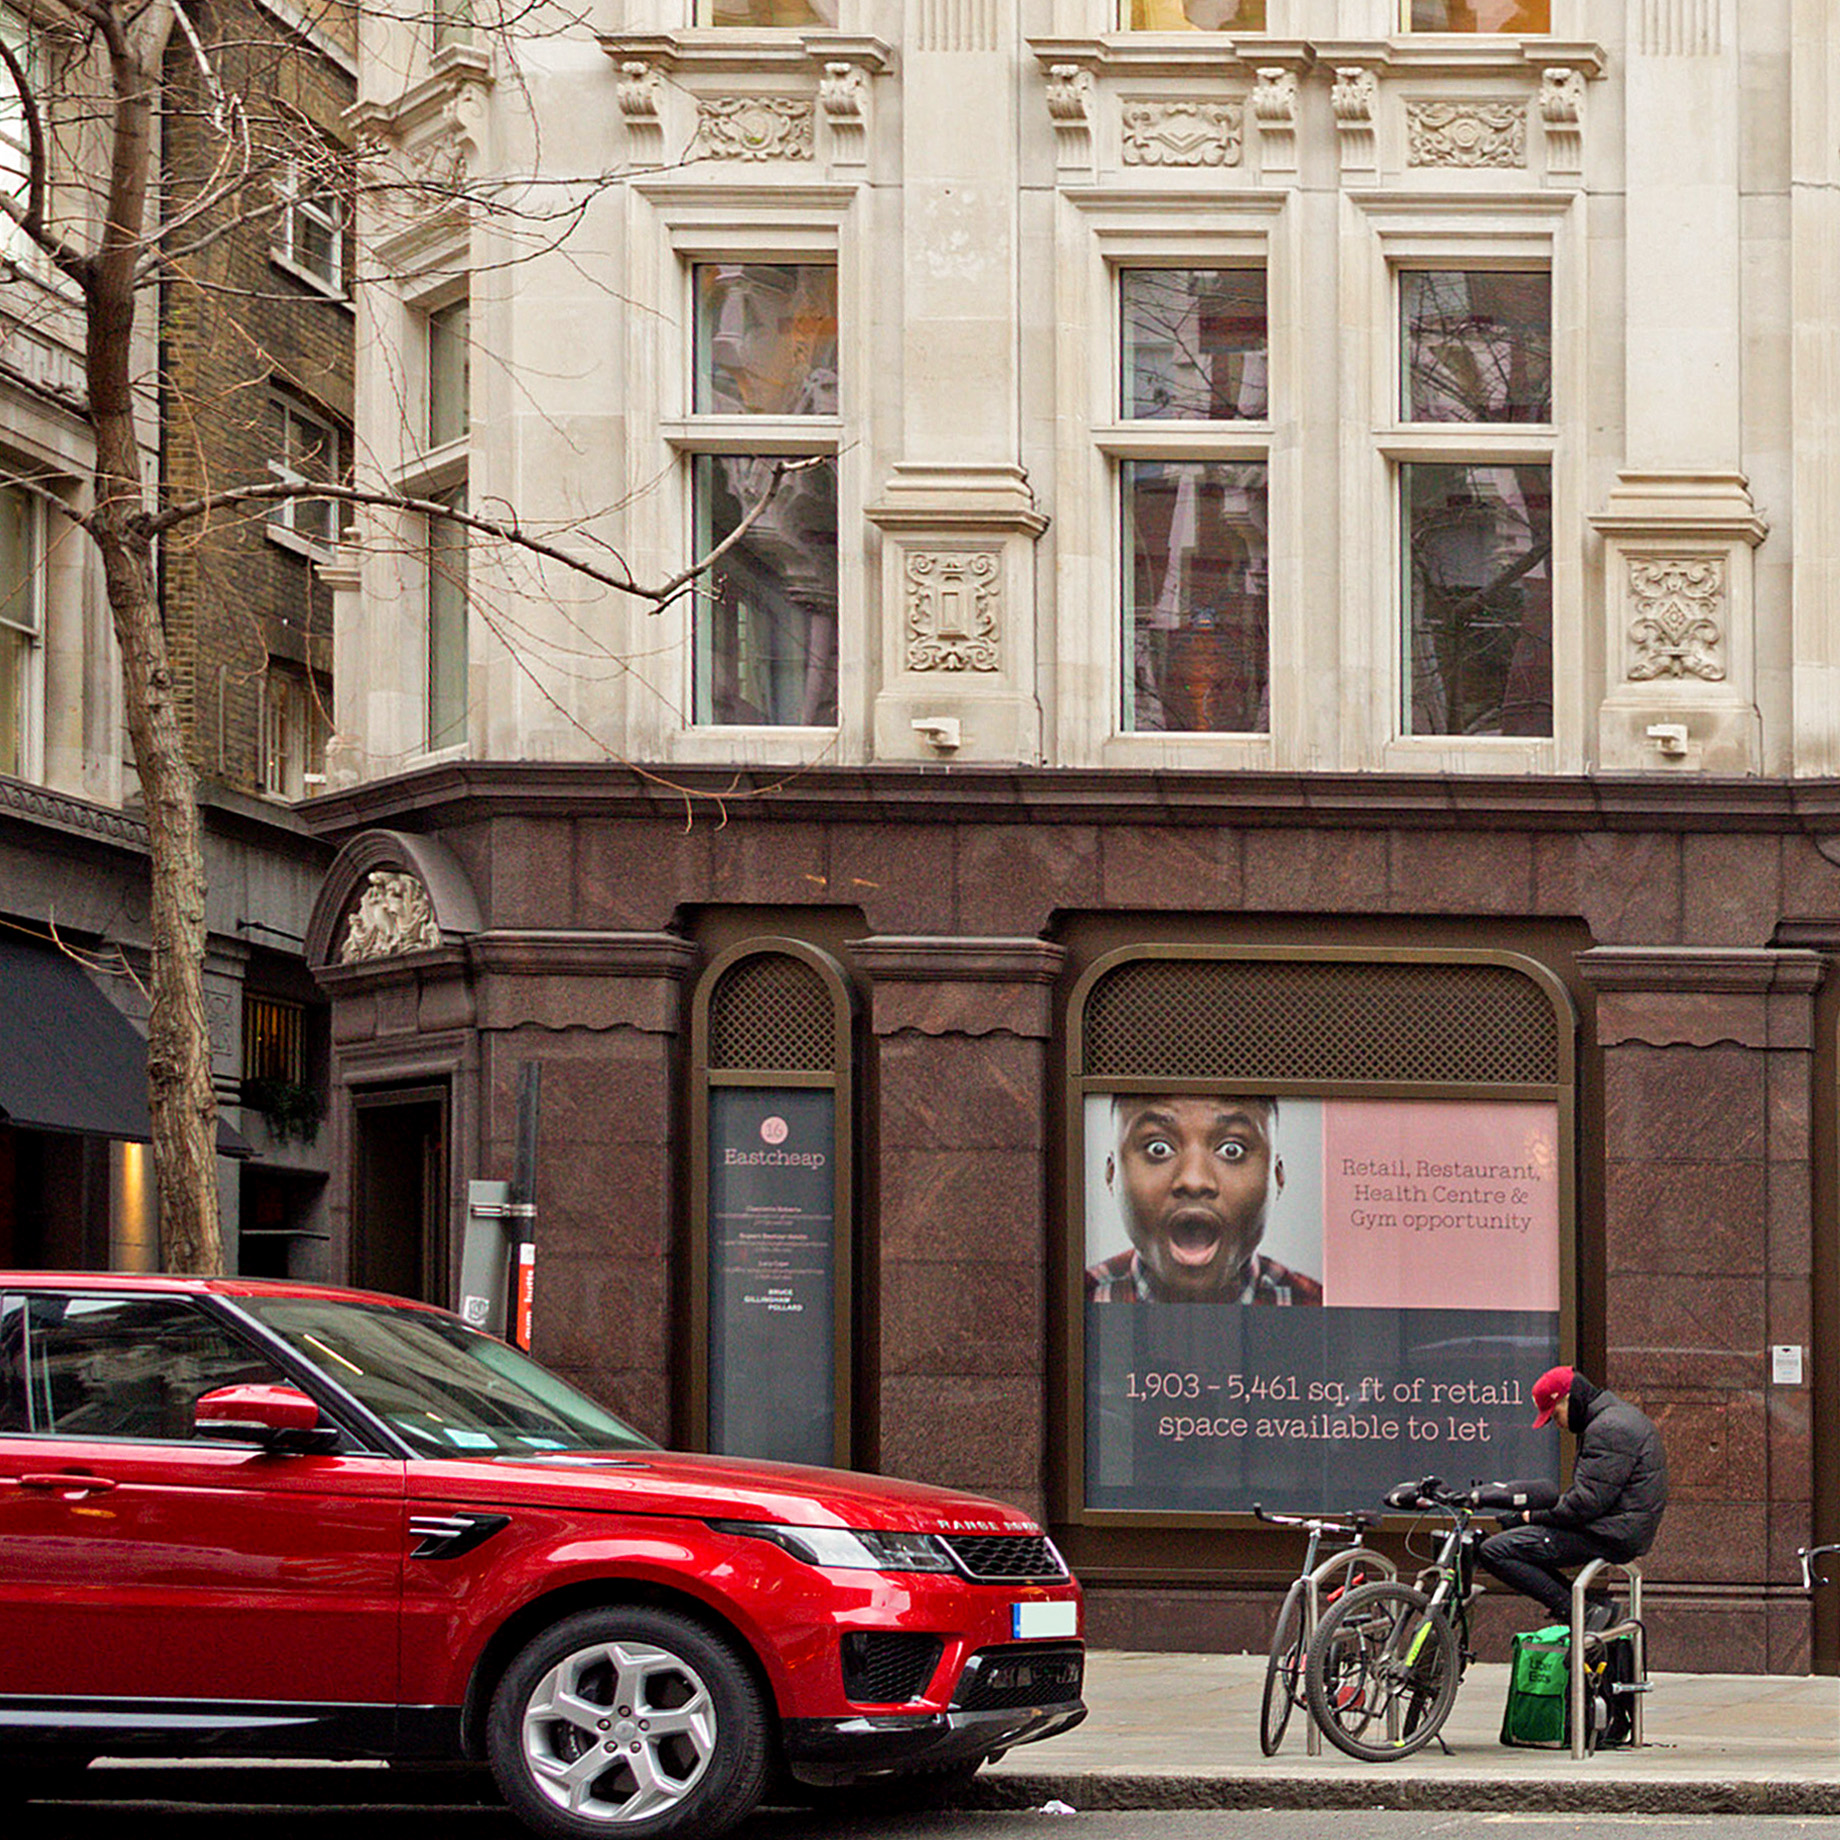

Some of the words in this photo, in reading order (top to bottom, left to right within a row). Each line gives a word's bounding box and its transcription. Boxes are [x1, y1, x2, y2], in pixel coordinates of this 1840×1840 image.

[766, 1123, 784, 1138] 16
[724, 1148, 826, 1170] Eastcheap
[1342, 1159, 1411, 1178] Retail,
[1416, 1160, 1540, 1181] Restaurant,
[1354, 1184, 1427, 1202] Health
[1432, 1185, 1506, 1204] Centre
[1511, 1187, 1529, 1204] &
[1350, 1209, 1397, 1230] Gym
[1402, 1212, 1532, 1233] opportunity
[1126, 1372, 1200, 1402] 1,903
[1228, 1374, 1301, 1403] 5,461
[1308, 1381, 1350, 1407] sq.
[1358, 1376, 1385, 1402] ft
[1393, 1377, 1425, 1403] of
[1431, 1379, 1523, 1405] retail
[1159, 1415, 1248, 1442] space
[1255, 1413, 1399, 1440] available
[1407, 1415, 1439, 1440] to
[1447, 1416, 1491, 1442] let
